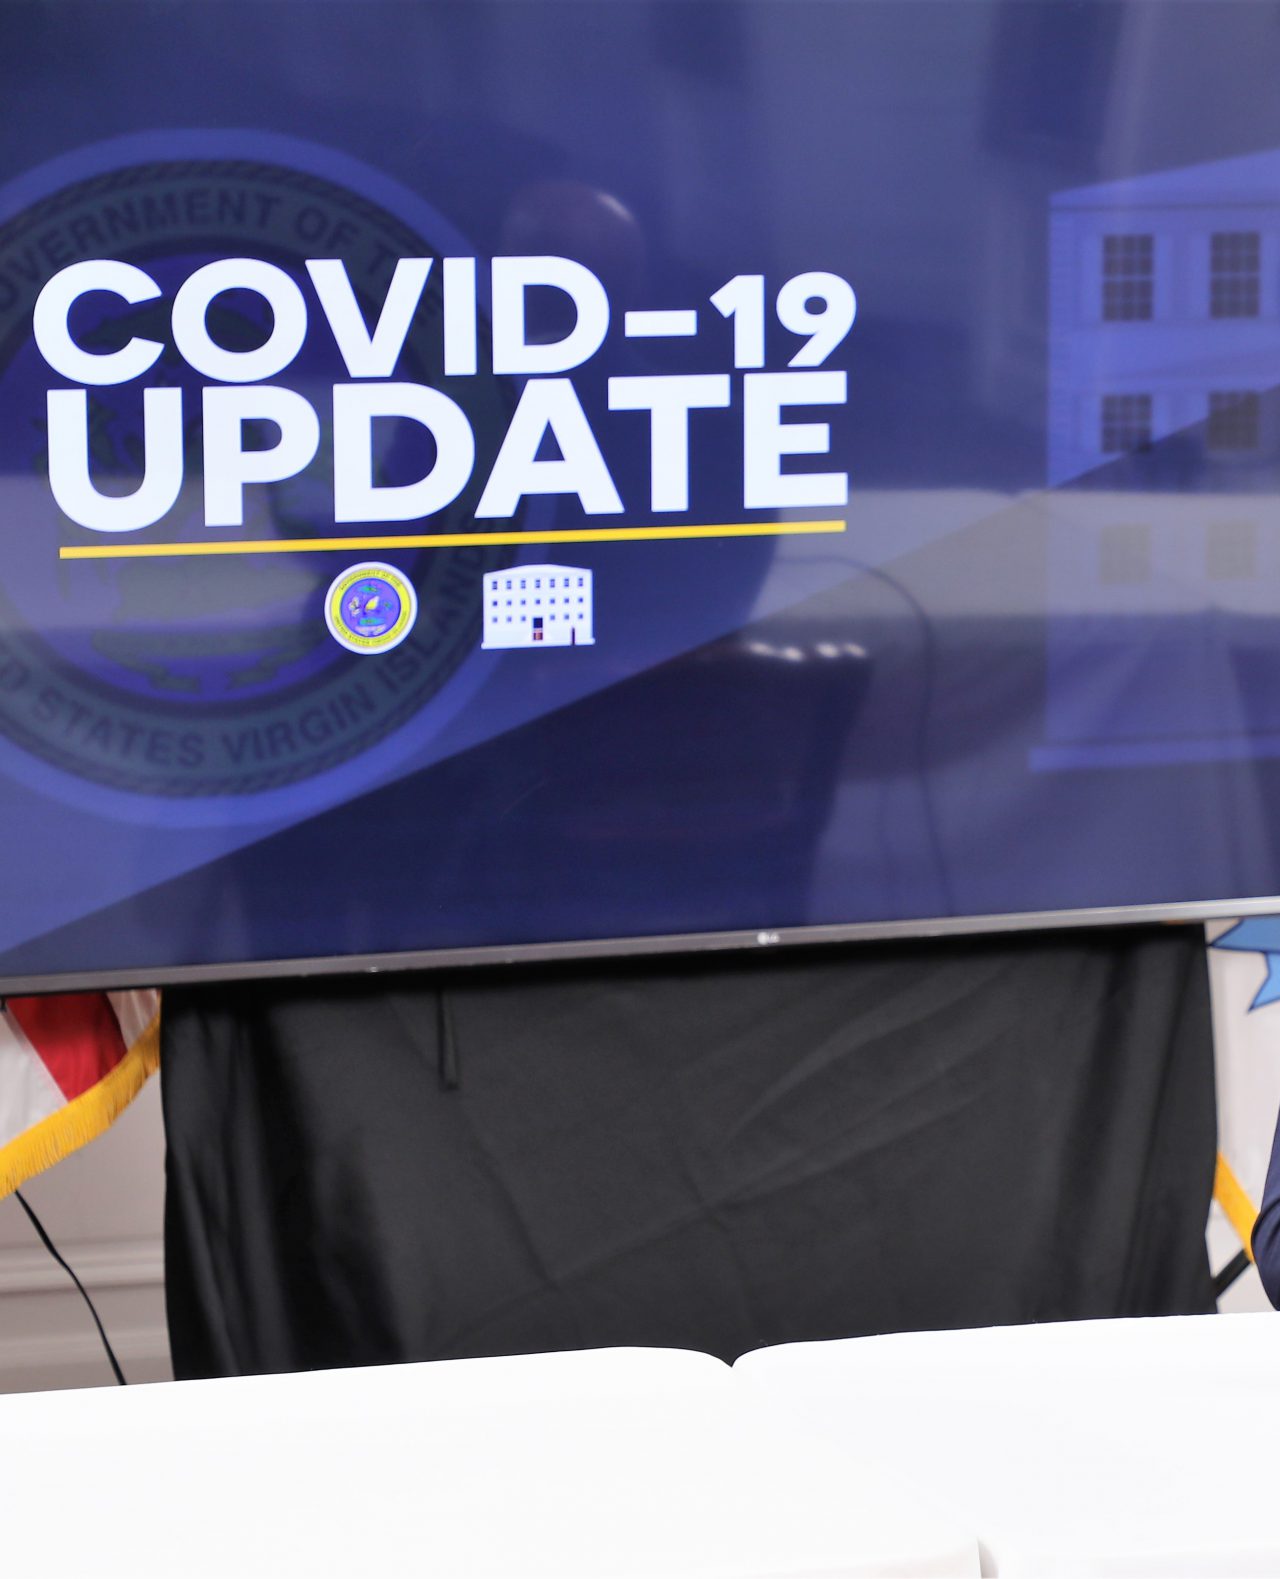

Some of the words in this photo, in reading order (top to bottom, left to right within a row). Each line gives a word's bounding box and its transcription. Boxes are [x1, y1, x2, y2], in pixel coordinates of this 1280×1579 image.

[0, 189, 281, 307] OVERNMENT
[296, 202, 361, 251] OF
[33, 256, 857, 386] COVID-19
[46, 370, 849, 533] UPDATE
[35, 683, 203, 766] STATES
[222, 688, 377, 765] VIRGIN
